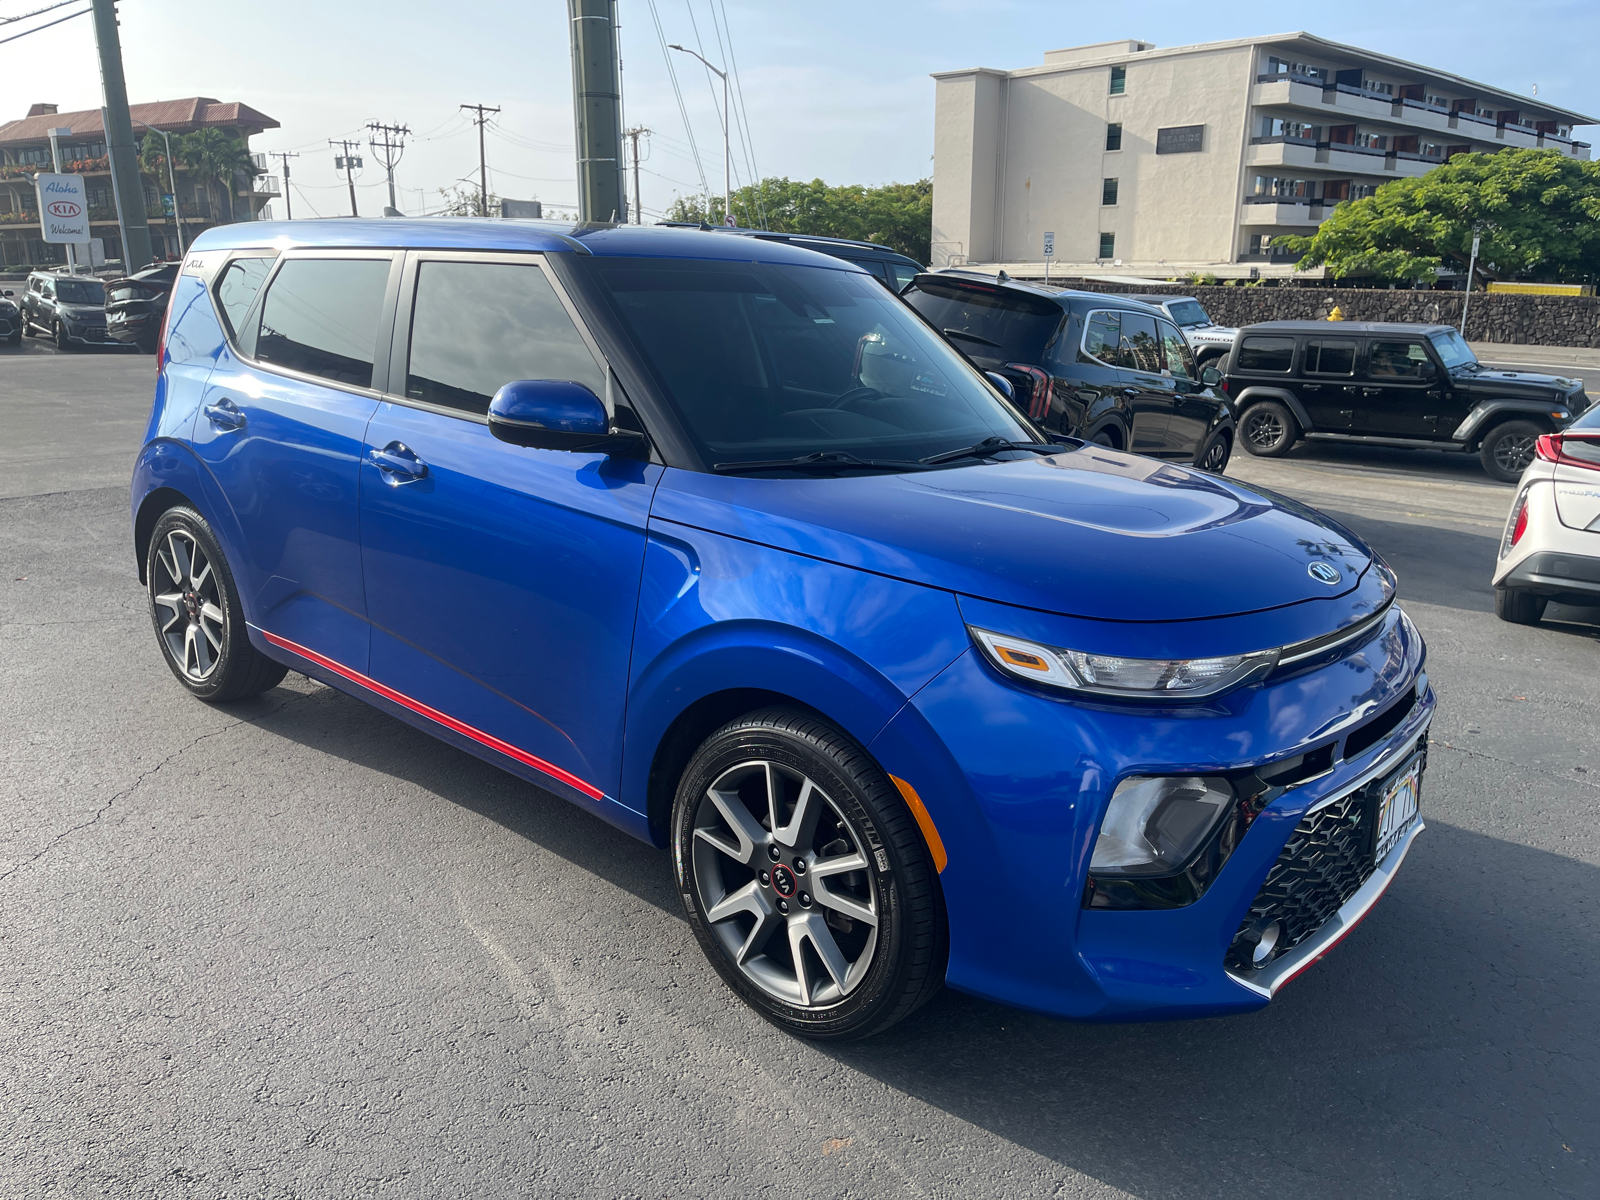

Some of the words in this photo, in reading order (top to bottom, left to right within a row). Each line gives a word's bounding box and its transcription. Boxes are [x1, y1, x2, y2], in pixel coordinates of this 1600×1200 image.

[1160, 133, 1200, 144] SEASIDE
[45, 181, 79, 194] Aloha
[53, 204, 77, 214] KIA
[49, 223, 84, 235] Welcome!
[1044, 244, 1053, 254] 25
[824, 769, 883, 849] MICHELIN
[775, 869, 790, 894] KIA
